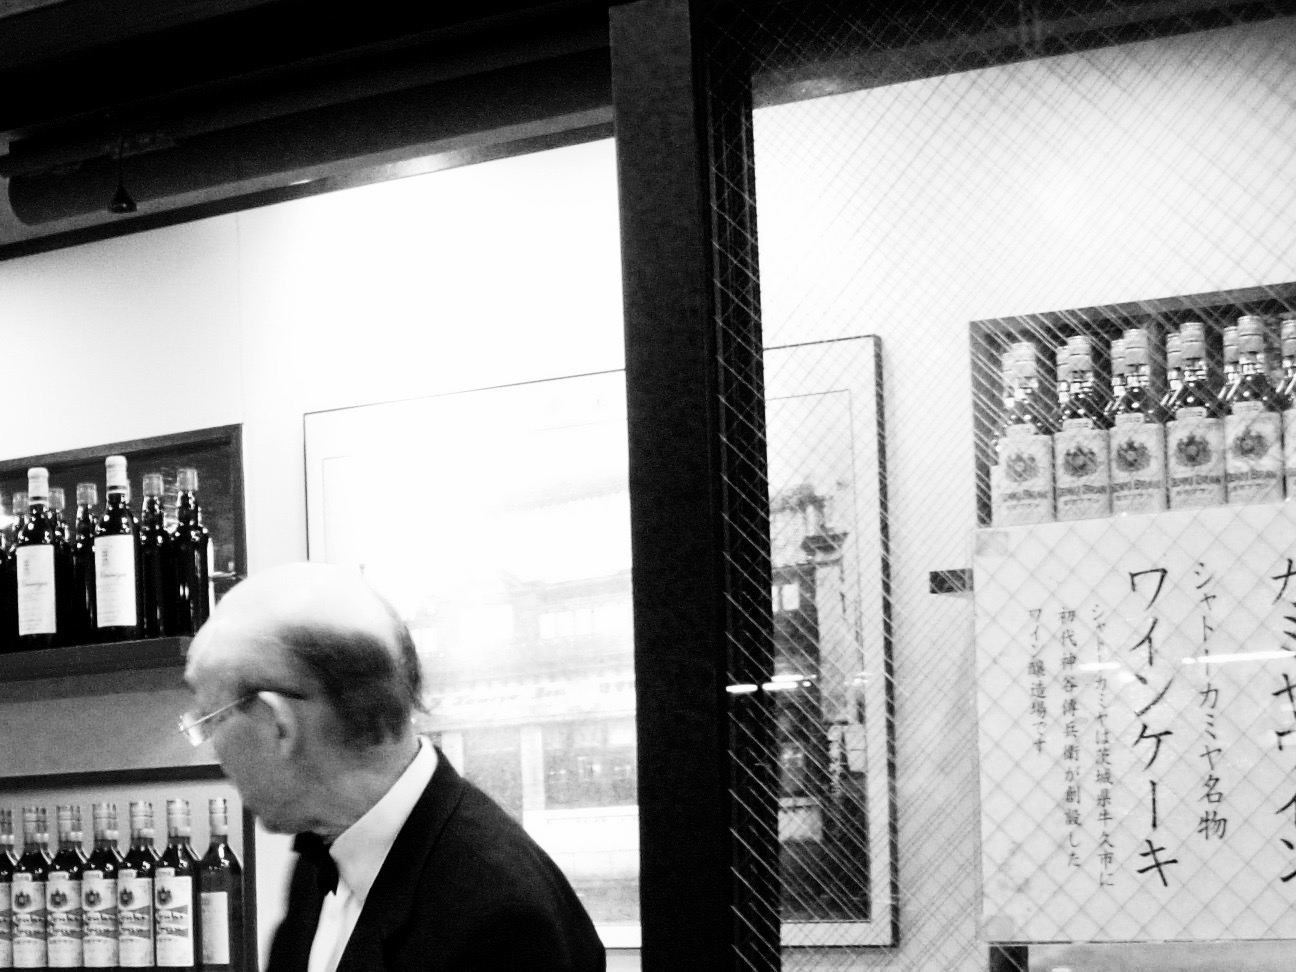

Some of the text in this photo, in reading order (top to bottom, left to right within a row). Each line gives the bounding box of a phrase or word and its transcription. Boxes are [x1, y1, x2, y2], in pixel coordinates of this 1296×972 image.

[1127, 567, 1179, 888] ワインケーキ
